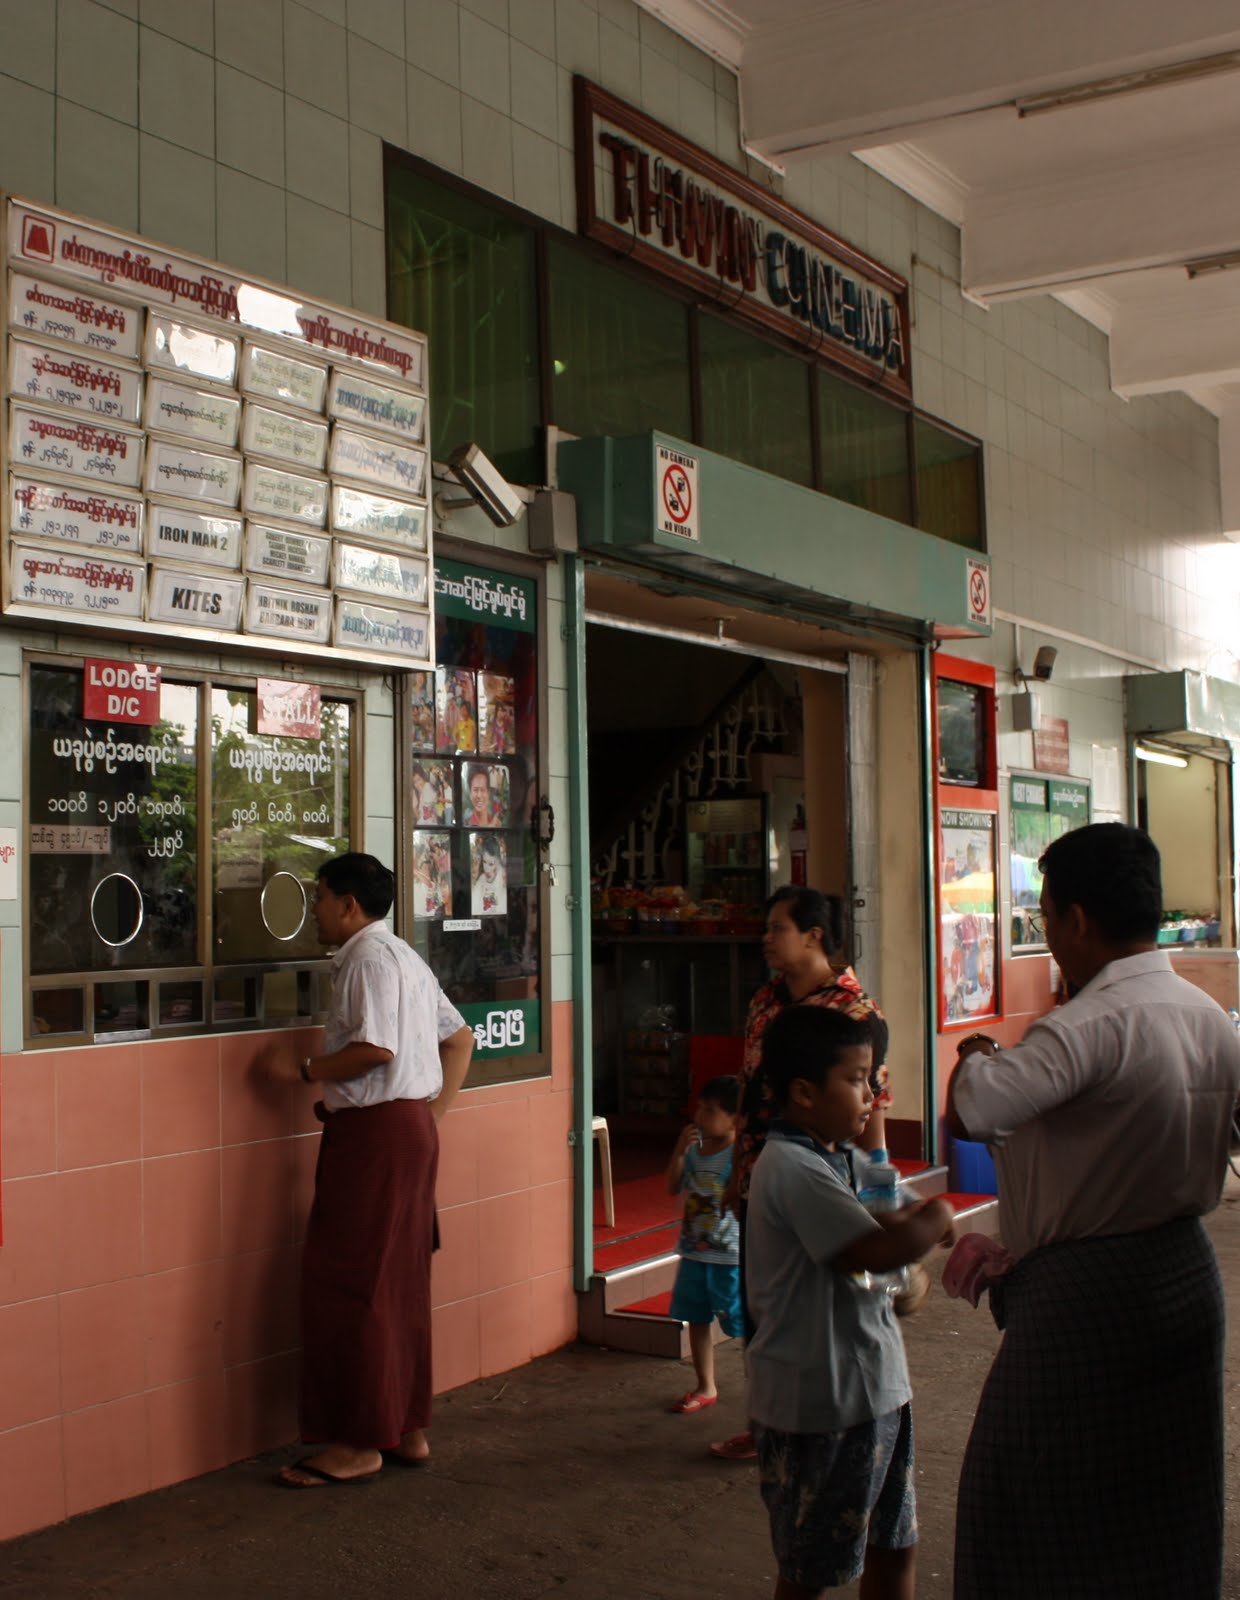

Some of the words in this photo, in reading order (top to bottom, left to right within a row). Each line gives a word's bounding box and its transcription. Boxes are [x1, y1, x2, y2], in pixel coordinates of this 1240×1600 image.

[766, 232, 905, 368] CINEMA
[660, 449, 668, 460] NO
[669, 452, 694, 469] CAMERA
[160, 525, 189, 544] IRON
[192, 531, 218, 549] MAN
[220, 536, 228, 551] 2
[664, 521, 673, 532] NO
[674, 523, 692, 538] VIDEO
[171, 587, 222, 614] KITES
[290, 601, 320, 616] ROSHAN
[90, 666, 157, 691] LODGE
[107, 694, 140, 717] D/C
[263, 695, 316, 725] STALL
[941, 811, 958, 826] NOW
[959, 812, 992, 828] SHOWING
